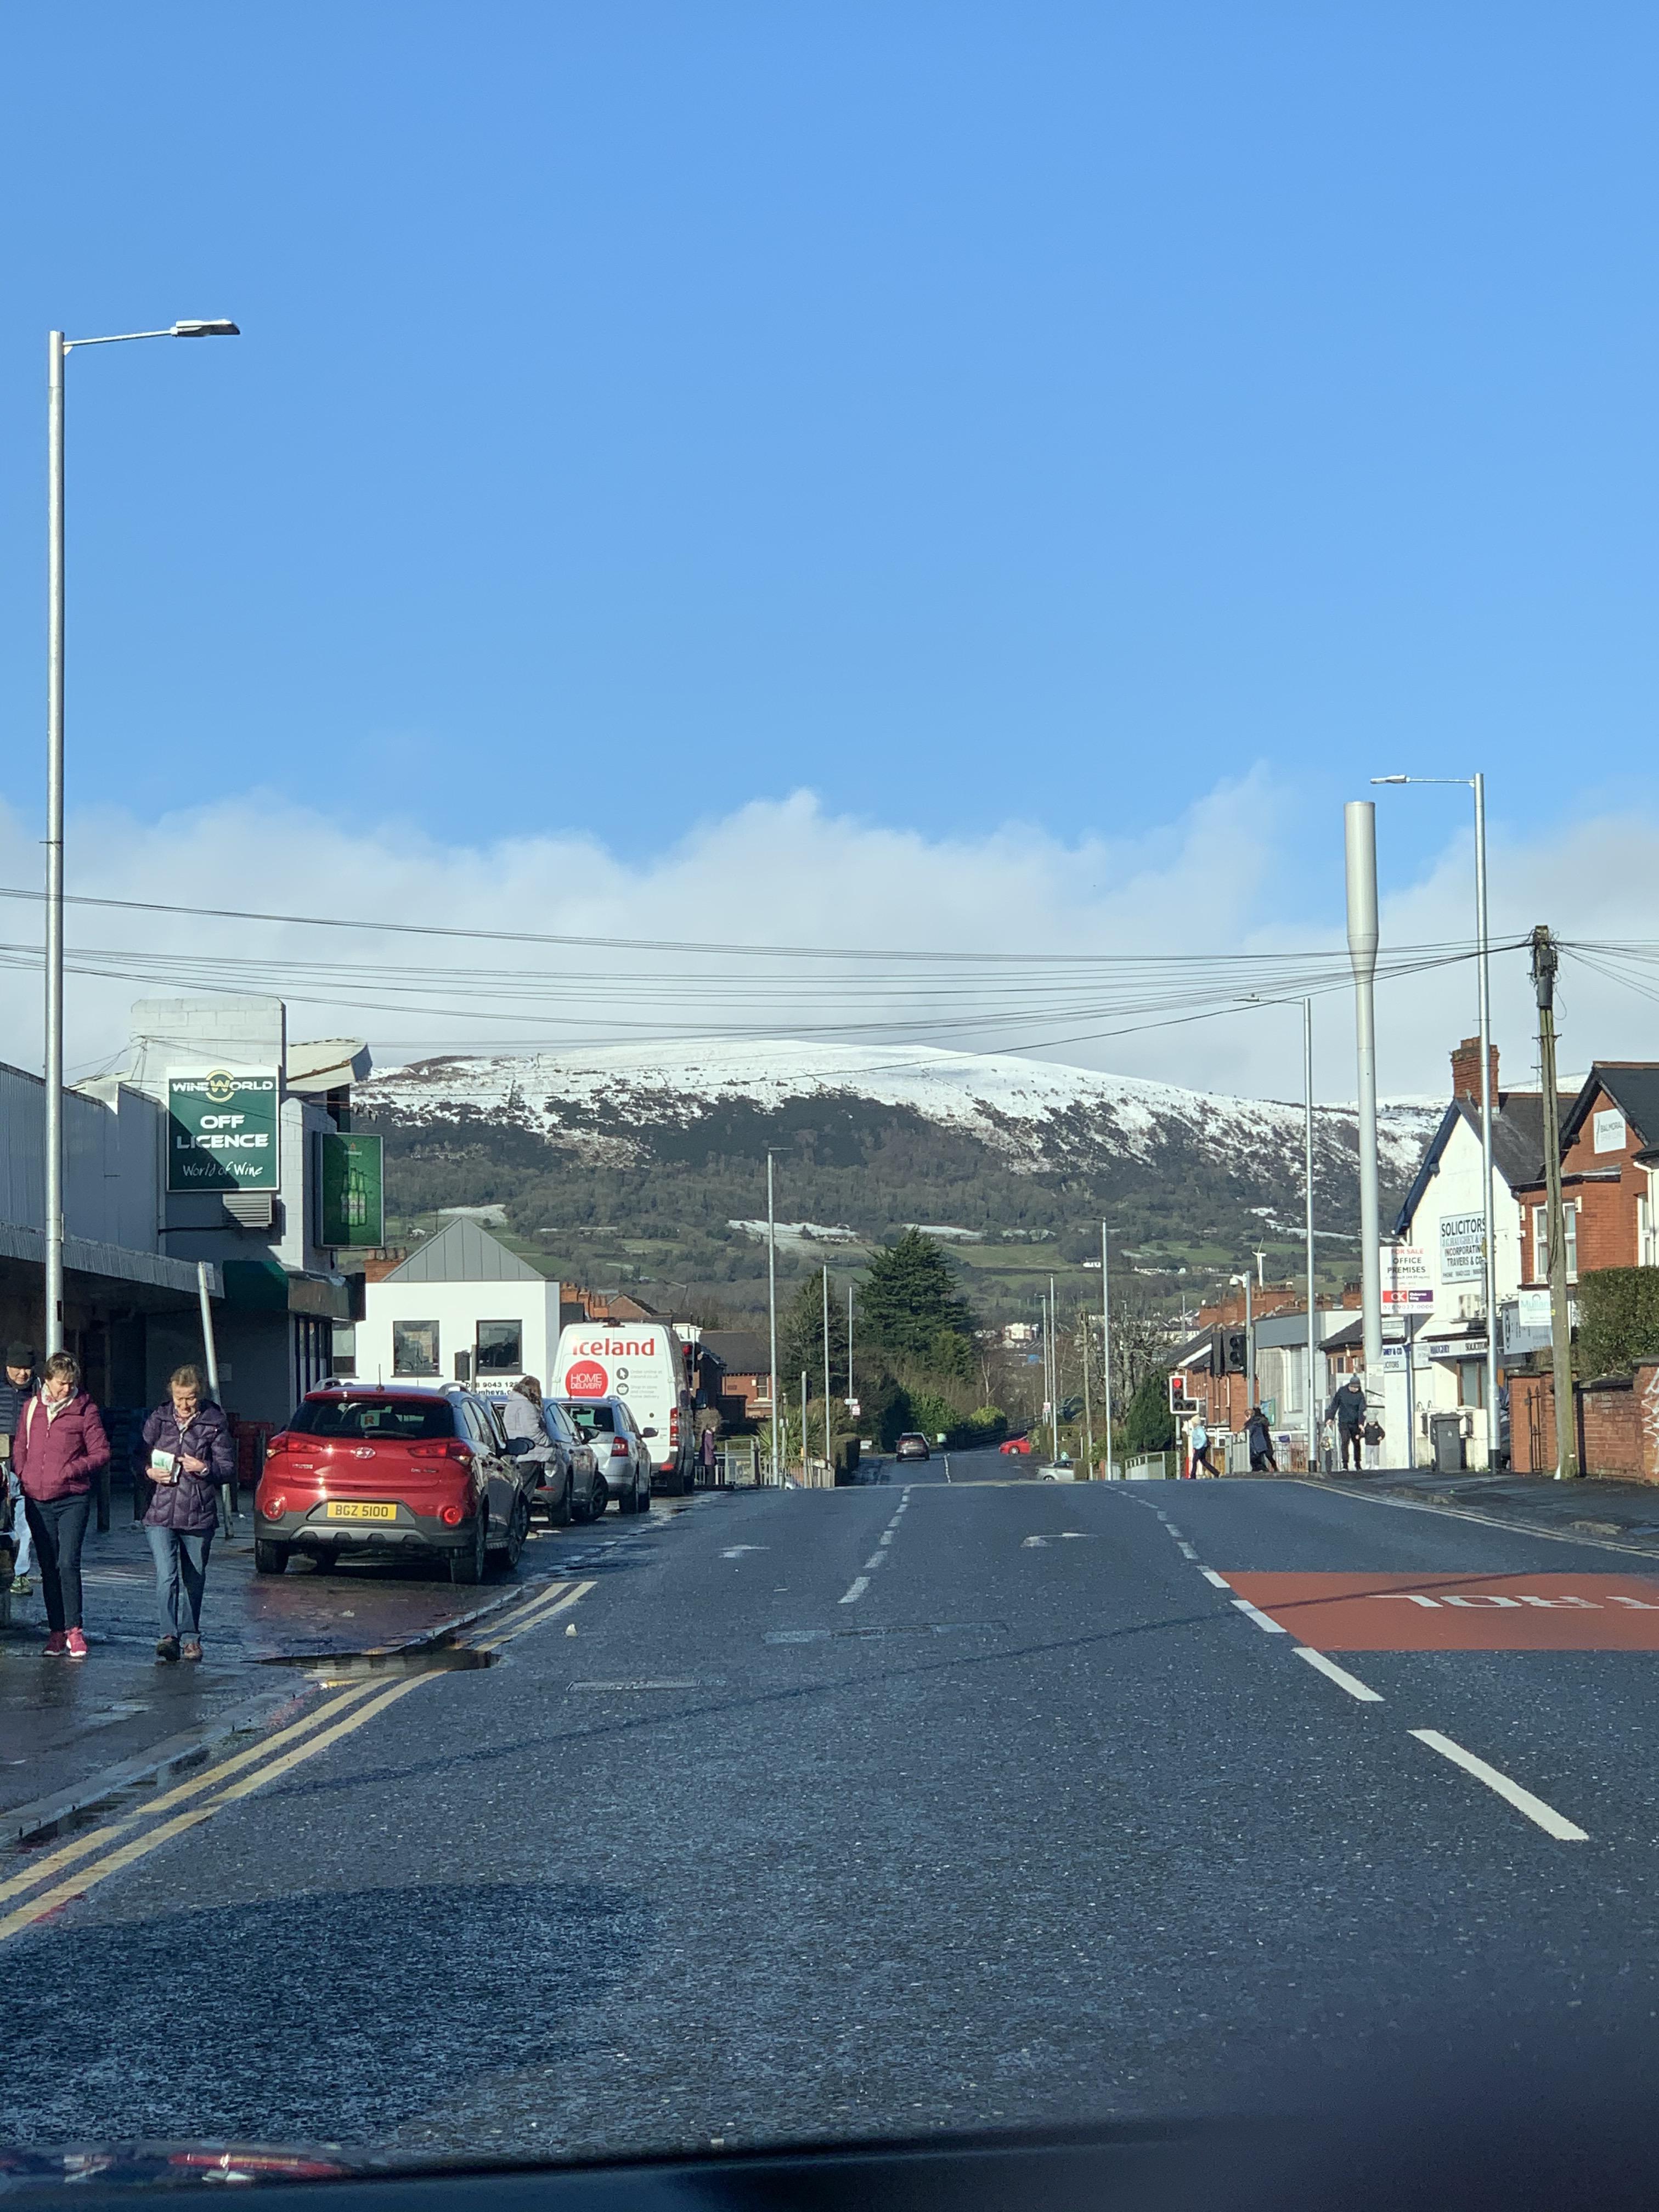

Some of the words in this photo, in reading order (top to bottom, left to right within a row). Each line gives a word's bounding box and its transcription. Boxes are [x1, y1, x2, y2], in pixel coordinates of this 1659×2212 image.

[200, 1115, 245, 1129] OFF
[177, 1133, 269, 1149] LICENCE
[183, 1163, 217, 1177] World
[218, 1161, 234, 1175] of
[234, 1162, 263, 1177] Wine
[1441, 1218, 1485, 1237] SOLICITORS
[573, 1338, 654, 1356] iceland
[571, 1373, 602, 1383] HOME
[364, 1415, 374, 1425] R
[335, 1505, 358, 1516] BGZ
[362, 1505, 388, 1517] 5100
